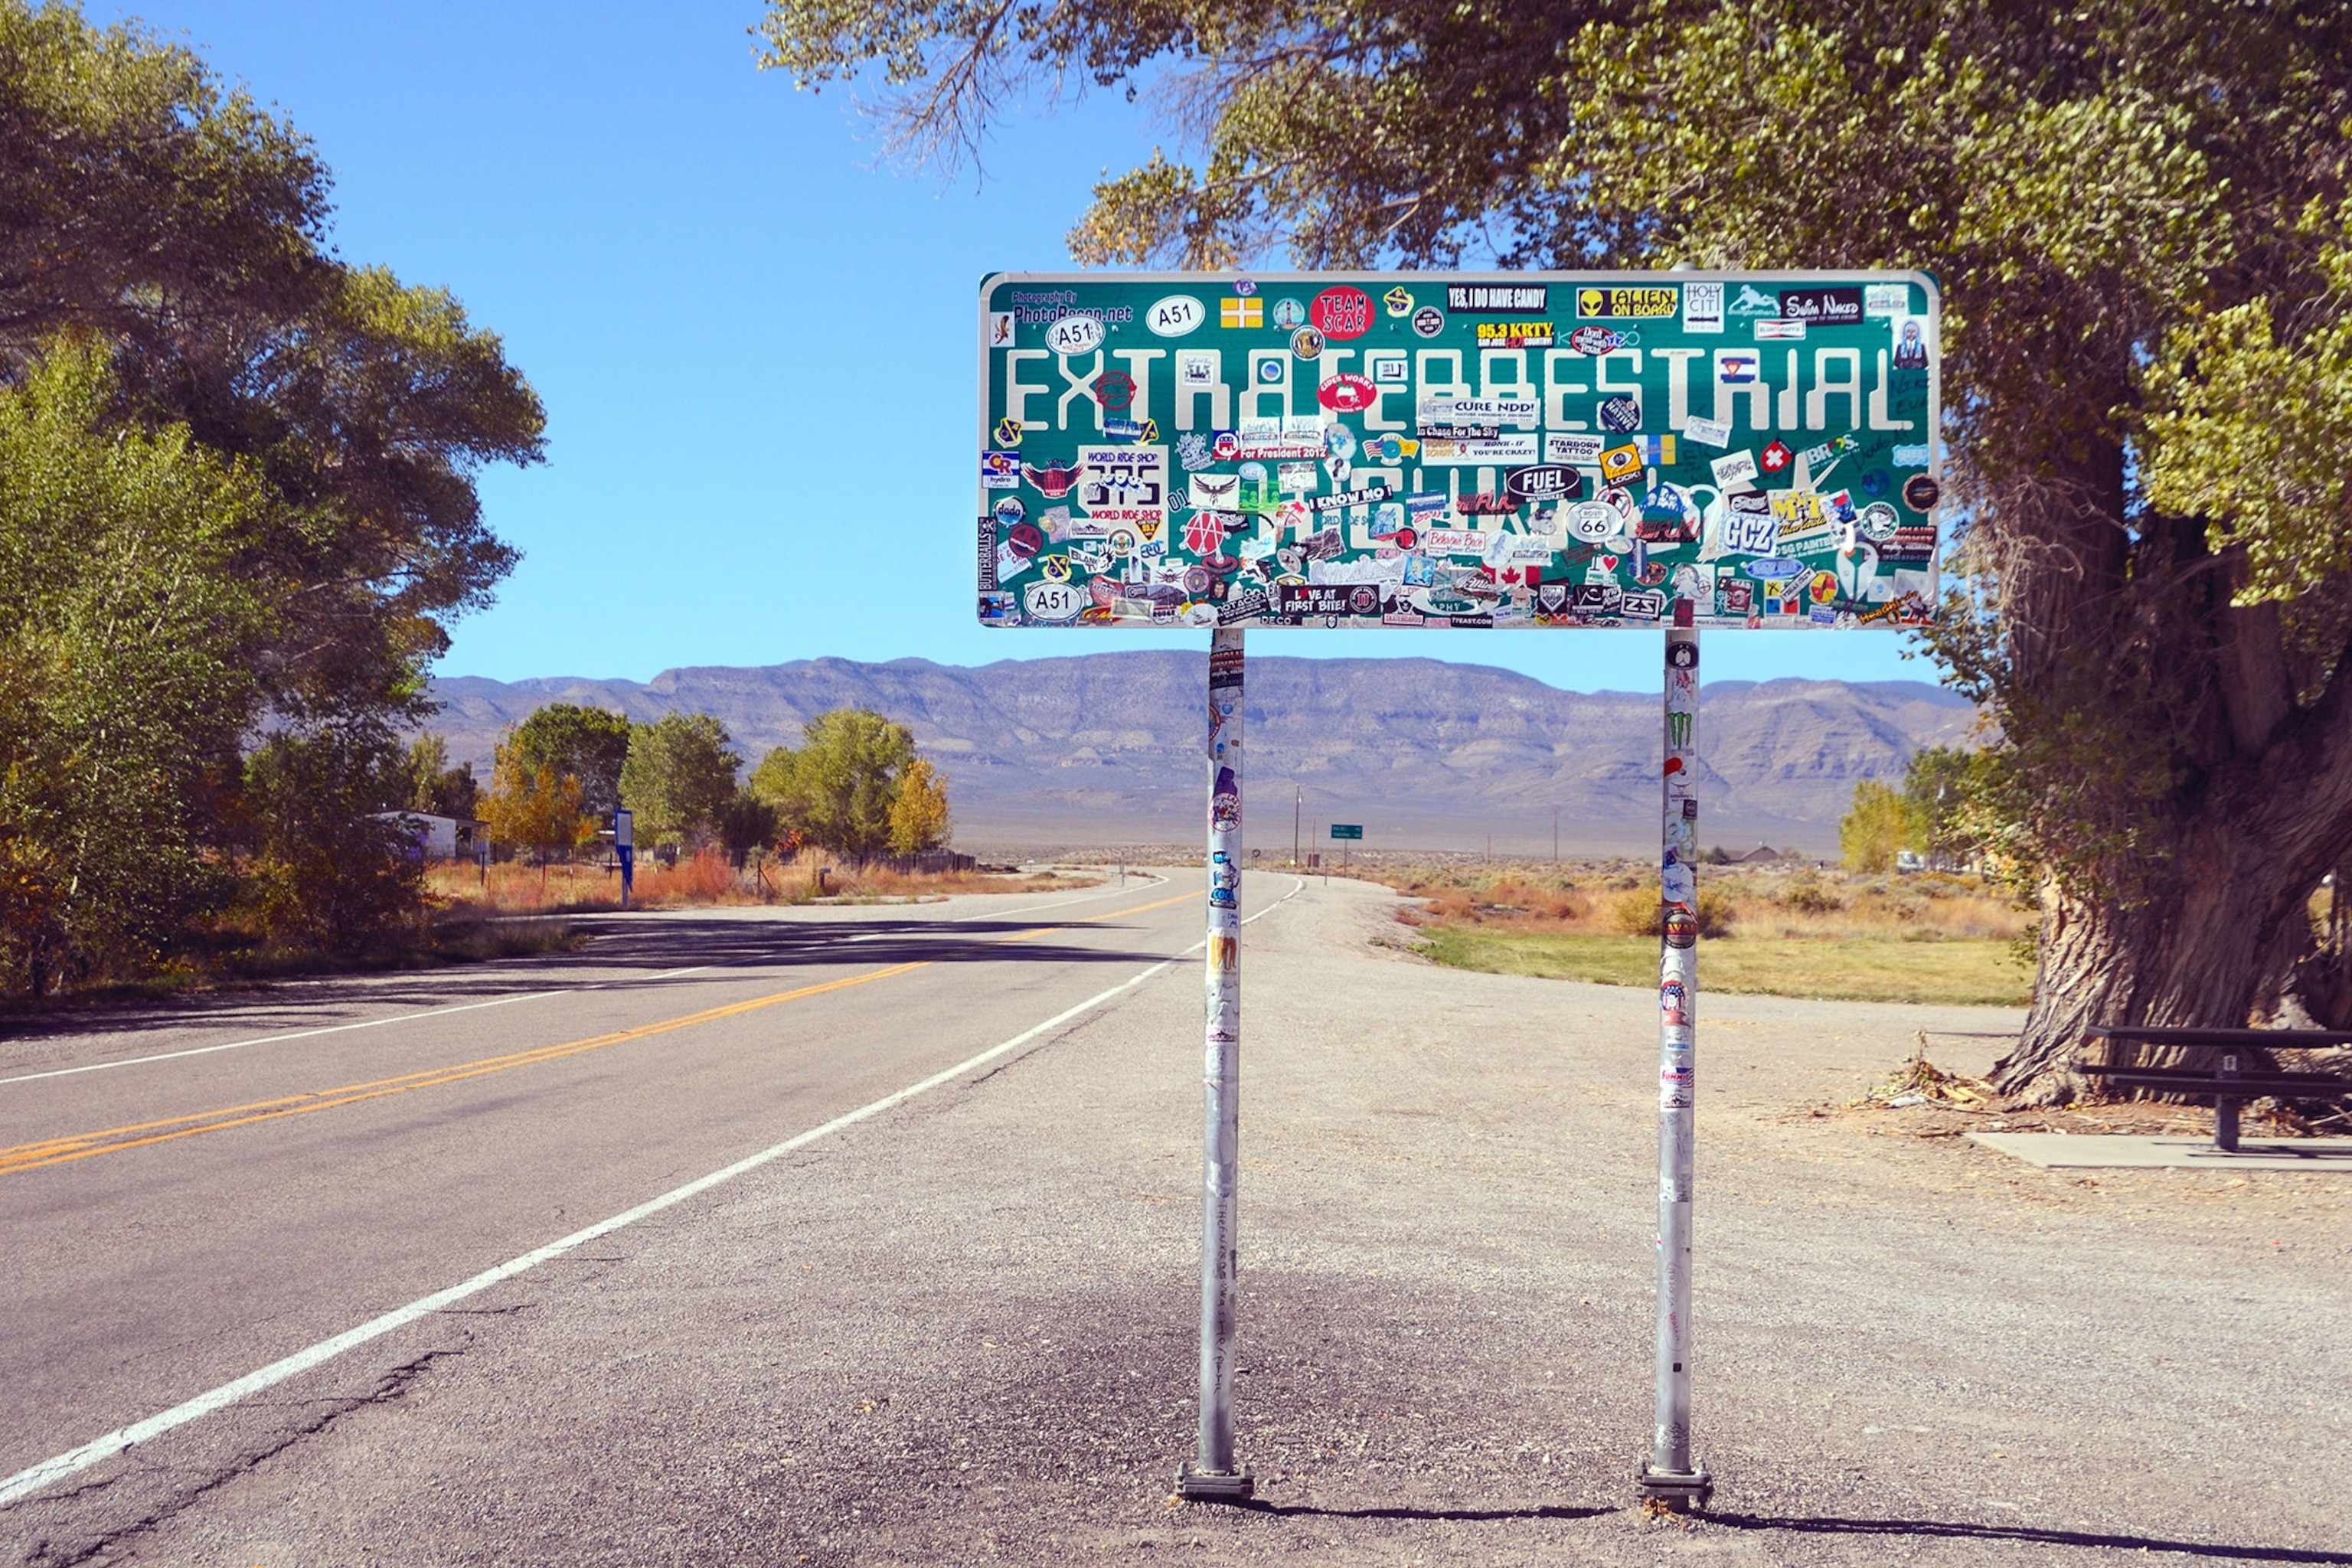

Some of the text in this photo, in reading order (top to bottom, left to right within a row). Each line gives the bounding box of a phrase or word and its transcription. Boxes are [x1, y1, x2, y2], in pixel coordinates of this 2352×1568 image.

[1013, 290, 1077, 304] Photography By
[1449, 287, 1546, 309] YES, I DO HAVE CANDY
[1616, 289, 1672, 304] ALIEN
[1321, 296, 1367, 314] TEAM
[1612, 303, 1675, 315] ON BOARD
[1159, 303, 1191, 327] A51
[1323, 314, 1365, 332] SCAR
[1477, 323, 1508, 338] 95.3
[1060, 322, 1091, 345] A51
[1007, 348, 1913, 430] EXTRATERRESTRIAL
[1320, 374, 1374, 393] CIDER WORKS
[1455, 402, 1535, 412] CURE NDD!
[1606, 397, 1632, 431] NATIVE
[1452, 426, 1467, 436] For
[1468, 426, 1481, 436] The
[1482, 426, 1498, 439] Sky
[1549, 439, 1601, 449] STARBORN
[1088, 452, 1158, 462] WORLD RIDE SHOP
[1240, 448, 1327, 459] For President 2012
[1523, 469, 1565, 491] FUEL
[1610, 471, 1642, 485] LOOK!
[1167, 488, 1191, 512] 01
[1317, 492, 1361, 508] KNOW
[1362, 488, 1385, 501] MO
[998, 504, 1021, 514] dada
[1092, 510, 1161, 520] WORLD RIDE SHOP
[1582, 520, 1606, 533] 66
[1724, 515, 1773, 552] GCZ
[978, 534, 993, 590] BUTTERBALLS
[1035, 591, 1069, 609] A51
[1324, 589, 1337, 599] AT
[1285, 599, 1346, 612] FIRST BITE!
[1261, 616, 1292, 625] DECO
[1385, 615, 1423, 624] SKATEBOARDS
